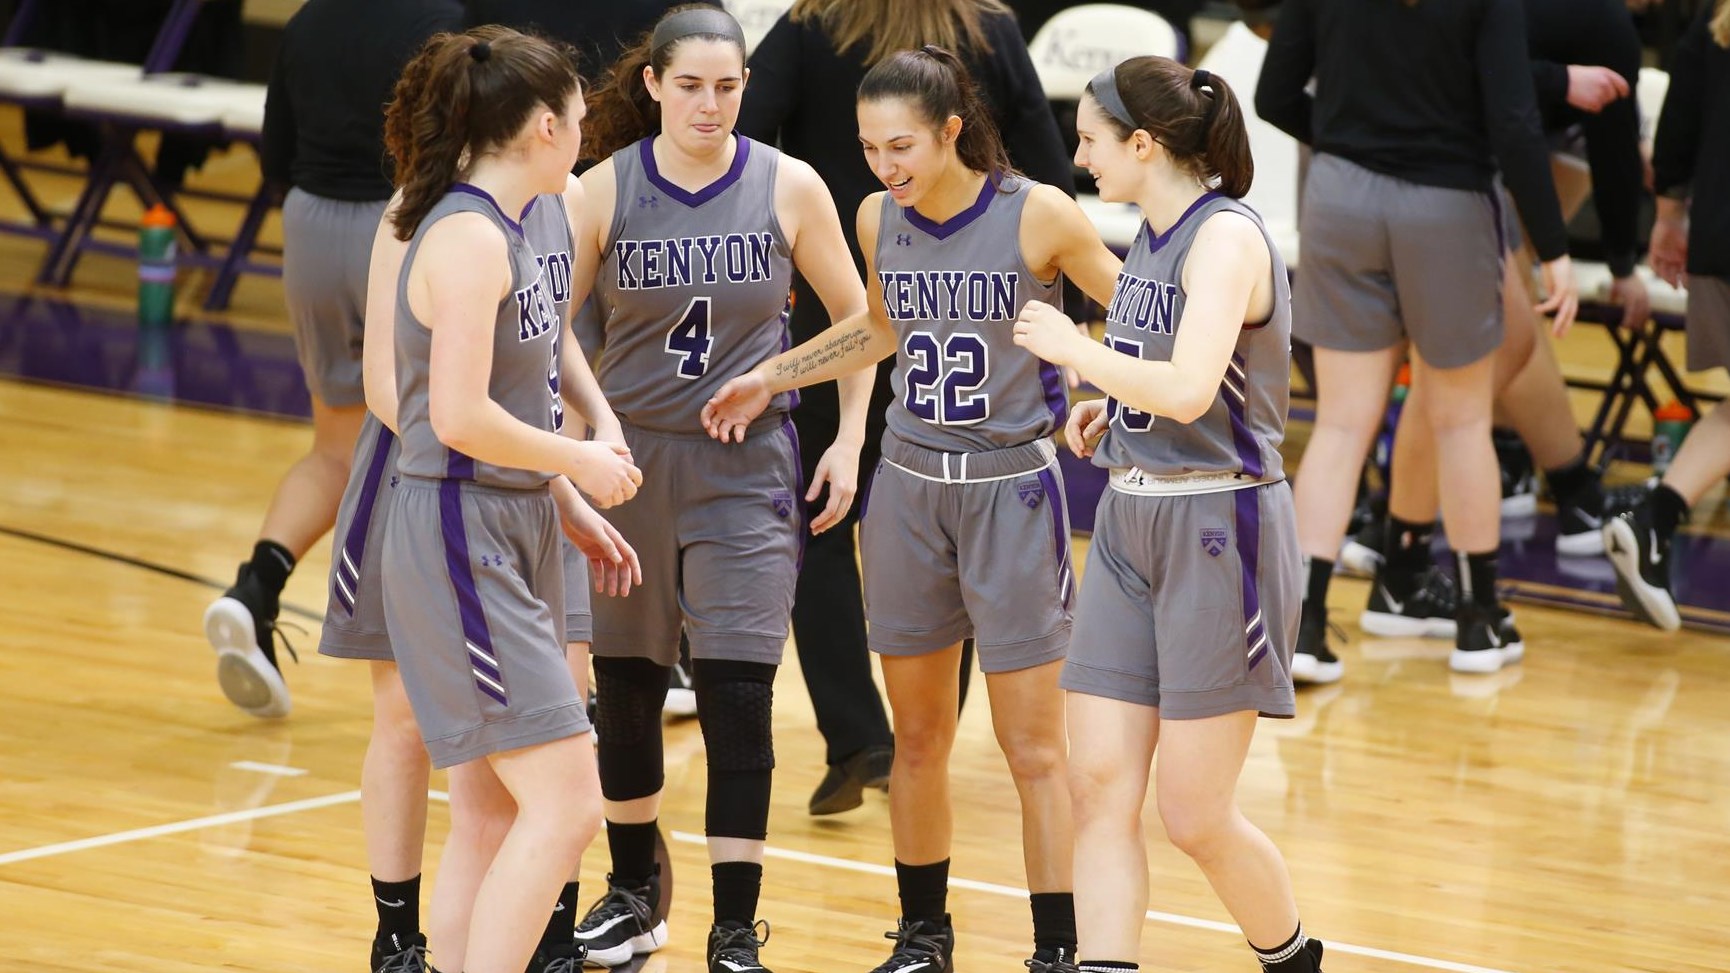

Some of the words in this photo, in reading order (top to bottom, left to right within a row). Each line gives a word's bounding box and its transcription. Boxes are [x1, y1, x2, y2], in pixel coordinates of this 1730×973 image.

[616, 232, 773, 289] KENYON
[879, 270, 1019, 322] KENYON
[664, 296, 715, 380] 4
[783, 357, 800, 372] will
[801, 347, 824, 362] never
[817, 350, 840, 366] never
[858, 333, 872, 352] you
[903, 331, 990, 426] 22
